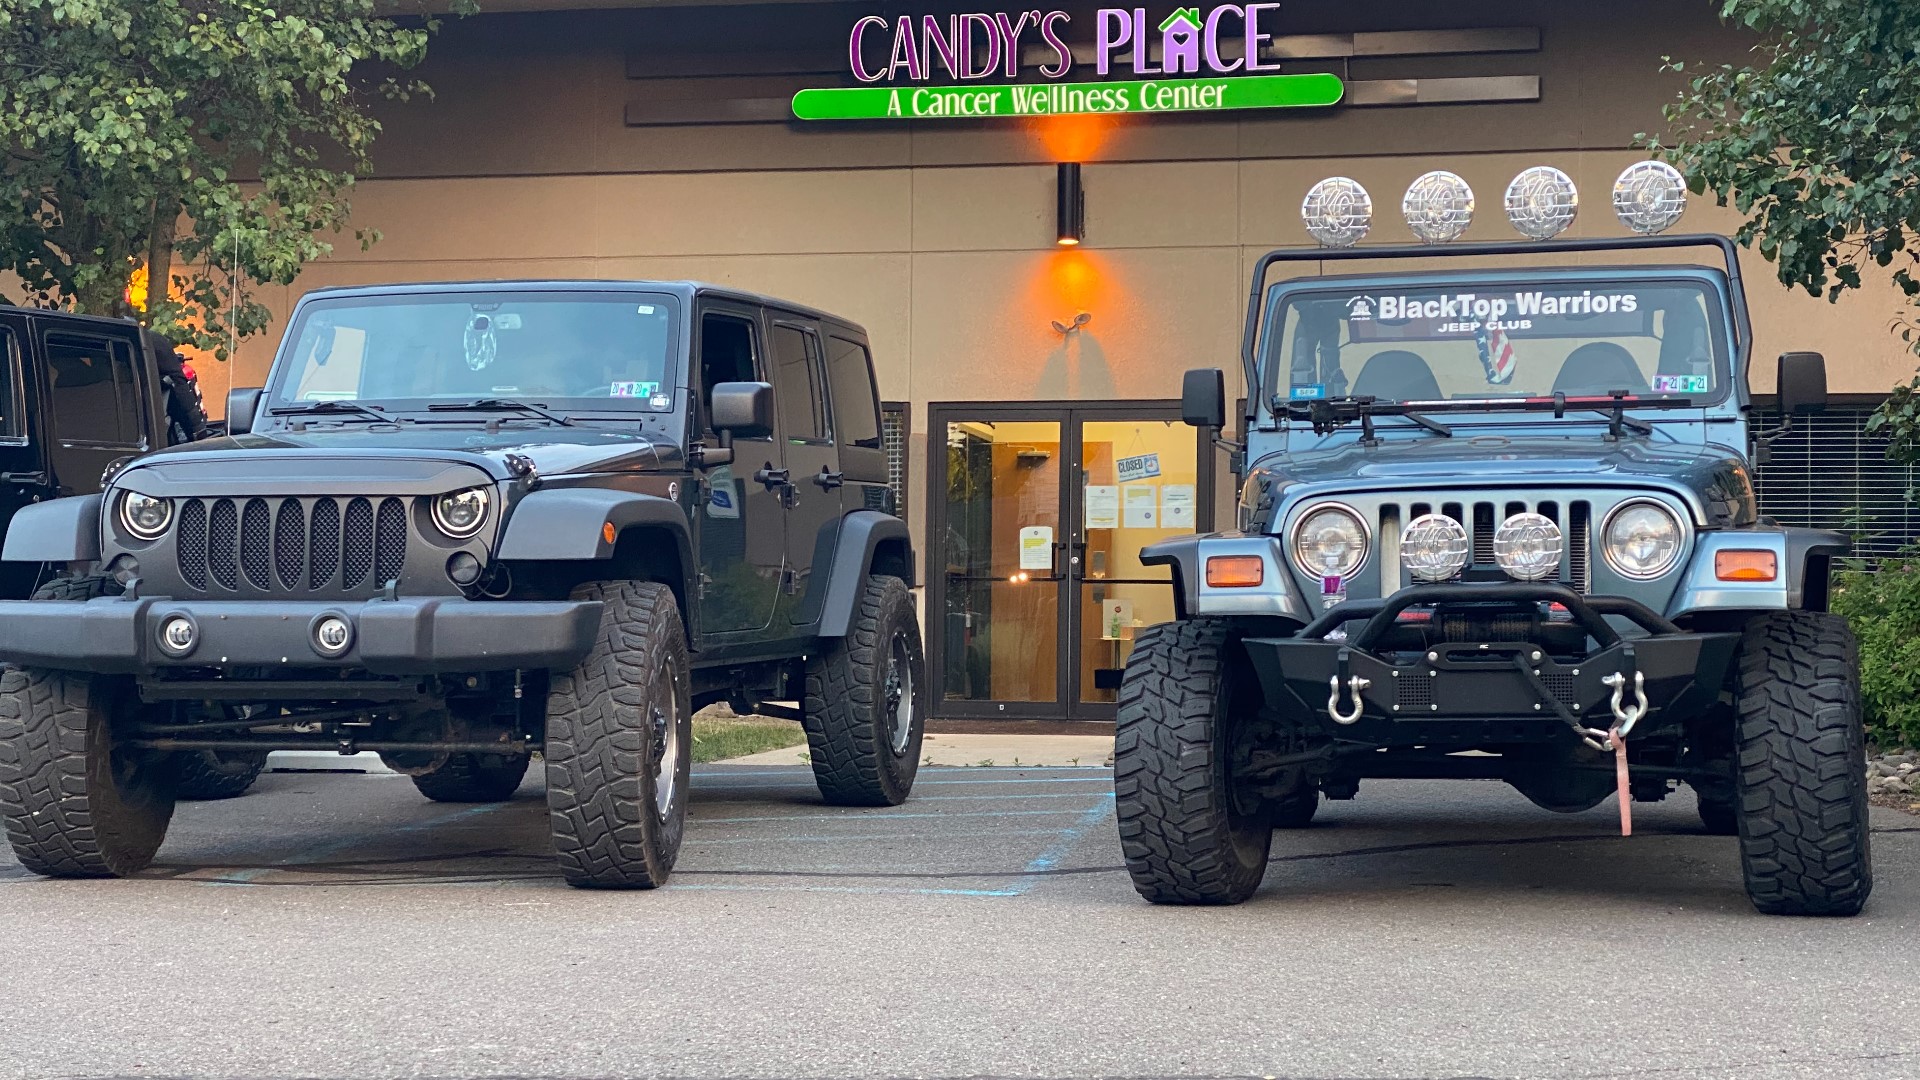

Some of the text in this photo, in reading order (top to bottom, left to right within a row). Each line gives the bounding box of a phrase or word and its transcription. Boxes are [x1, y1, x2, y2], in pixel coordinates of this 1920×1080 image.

[849, 4, 1281, 80] CANDY'S PLACE
[887, 81, 1228, 117] A Cancer Wellness Center
[1379, 291, 1638, 321] BlackTop Warriors
[1437, 320, 1532, 333] JEEP CLUB
[1118, 459, 1143, 473] CLOSED
